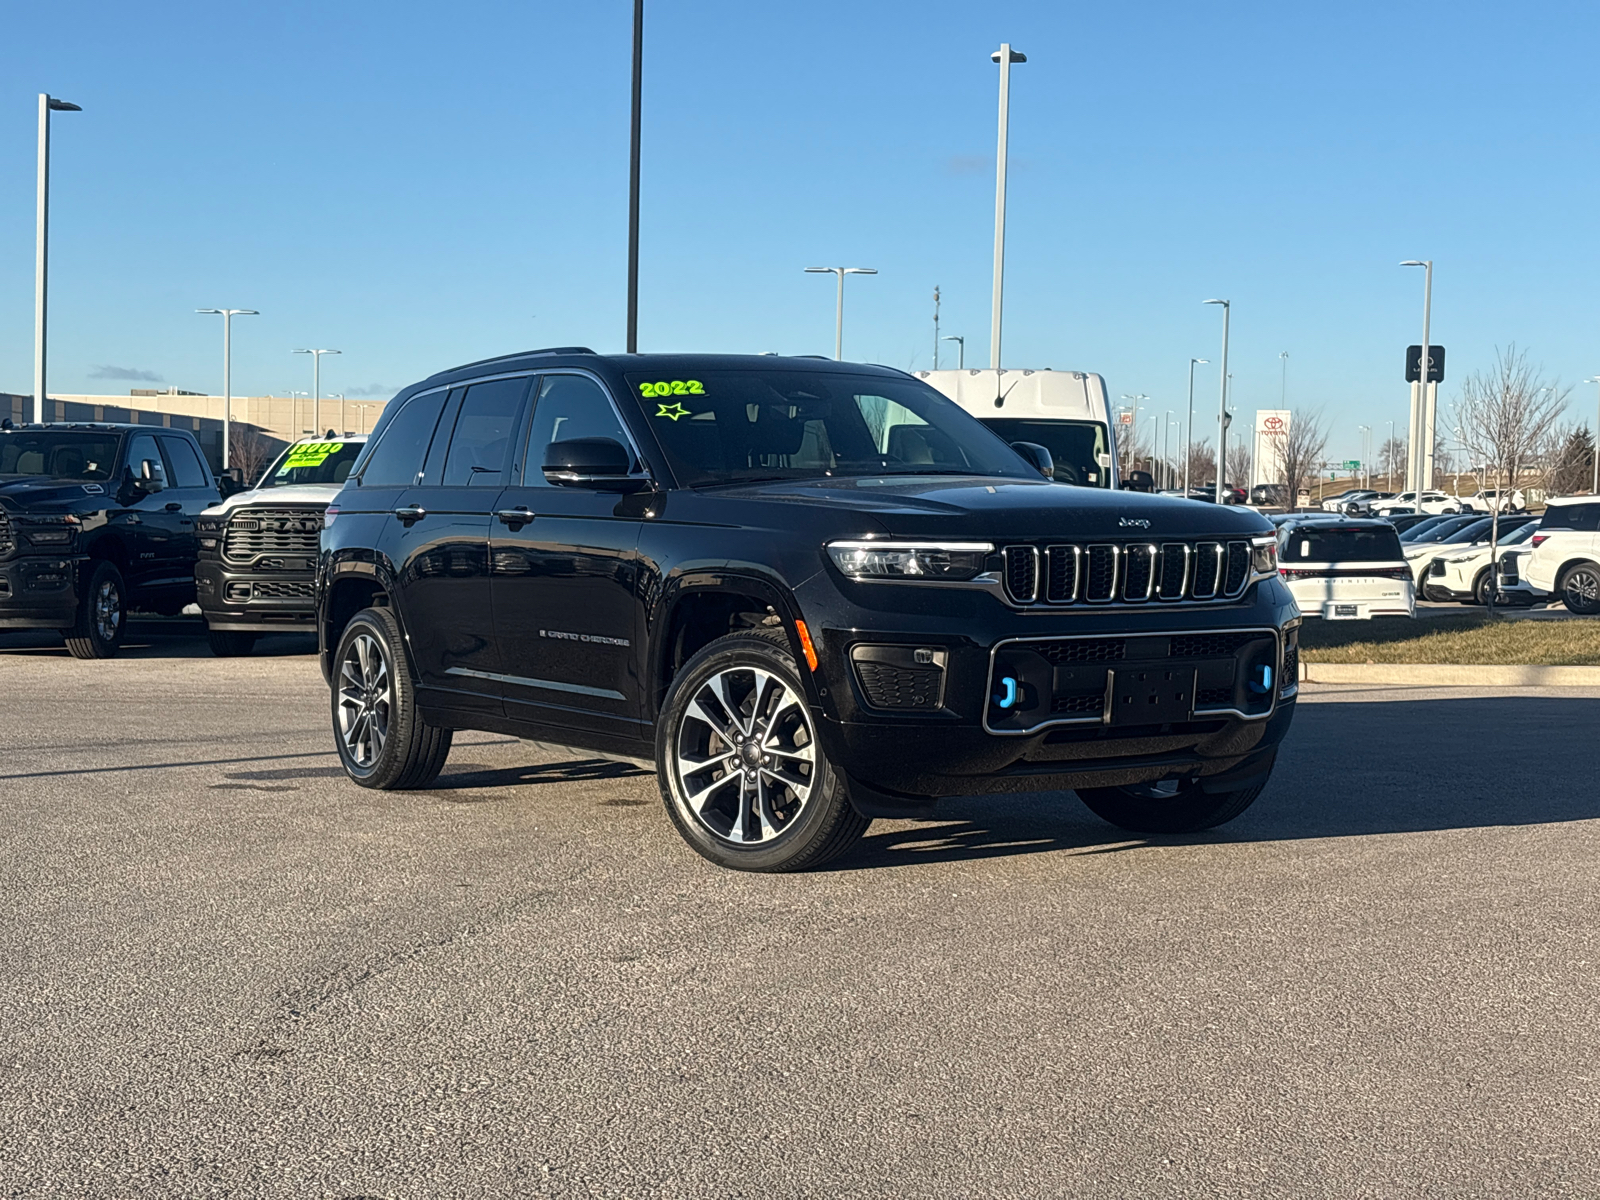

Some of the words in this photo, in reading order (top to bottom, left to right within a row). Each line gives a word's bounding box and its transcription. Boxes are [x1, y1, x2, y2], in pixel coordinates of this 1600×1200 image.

[639, 380, 706, 398] 2022
[259, 520, 325, 531] RAM
[1118, 516, 1151, 529] Jeep
[548, 630, 579, 641] GRAND
[580, 634, 630, 647] CHEROKEE
